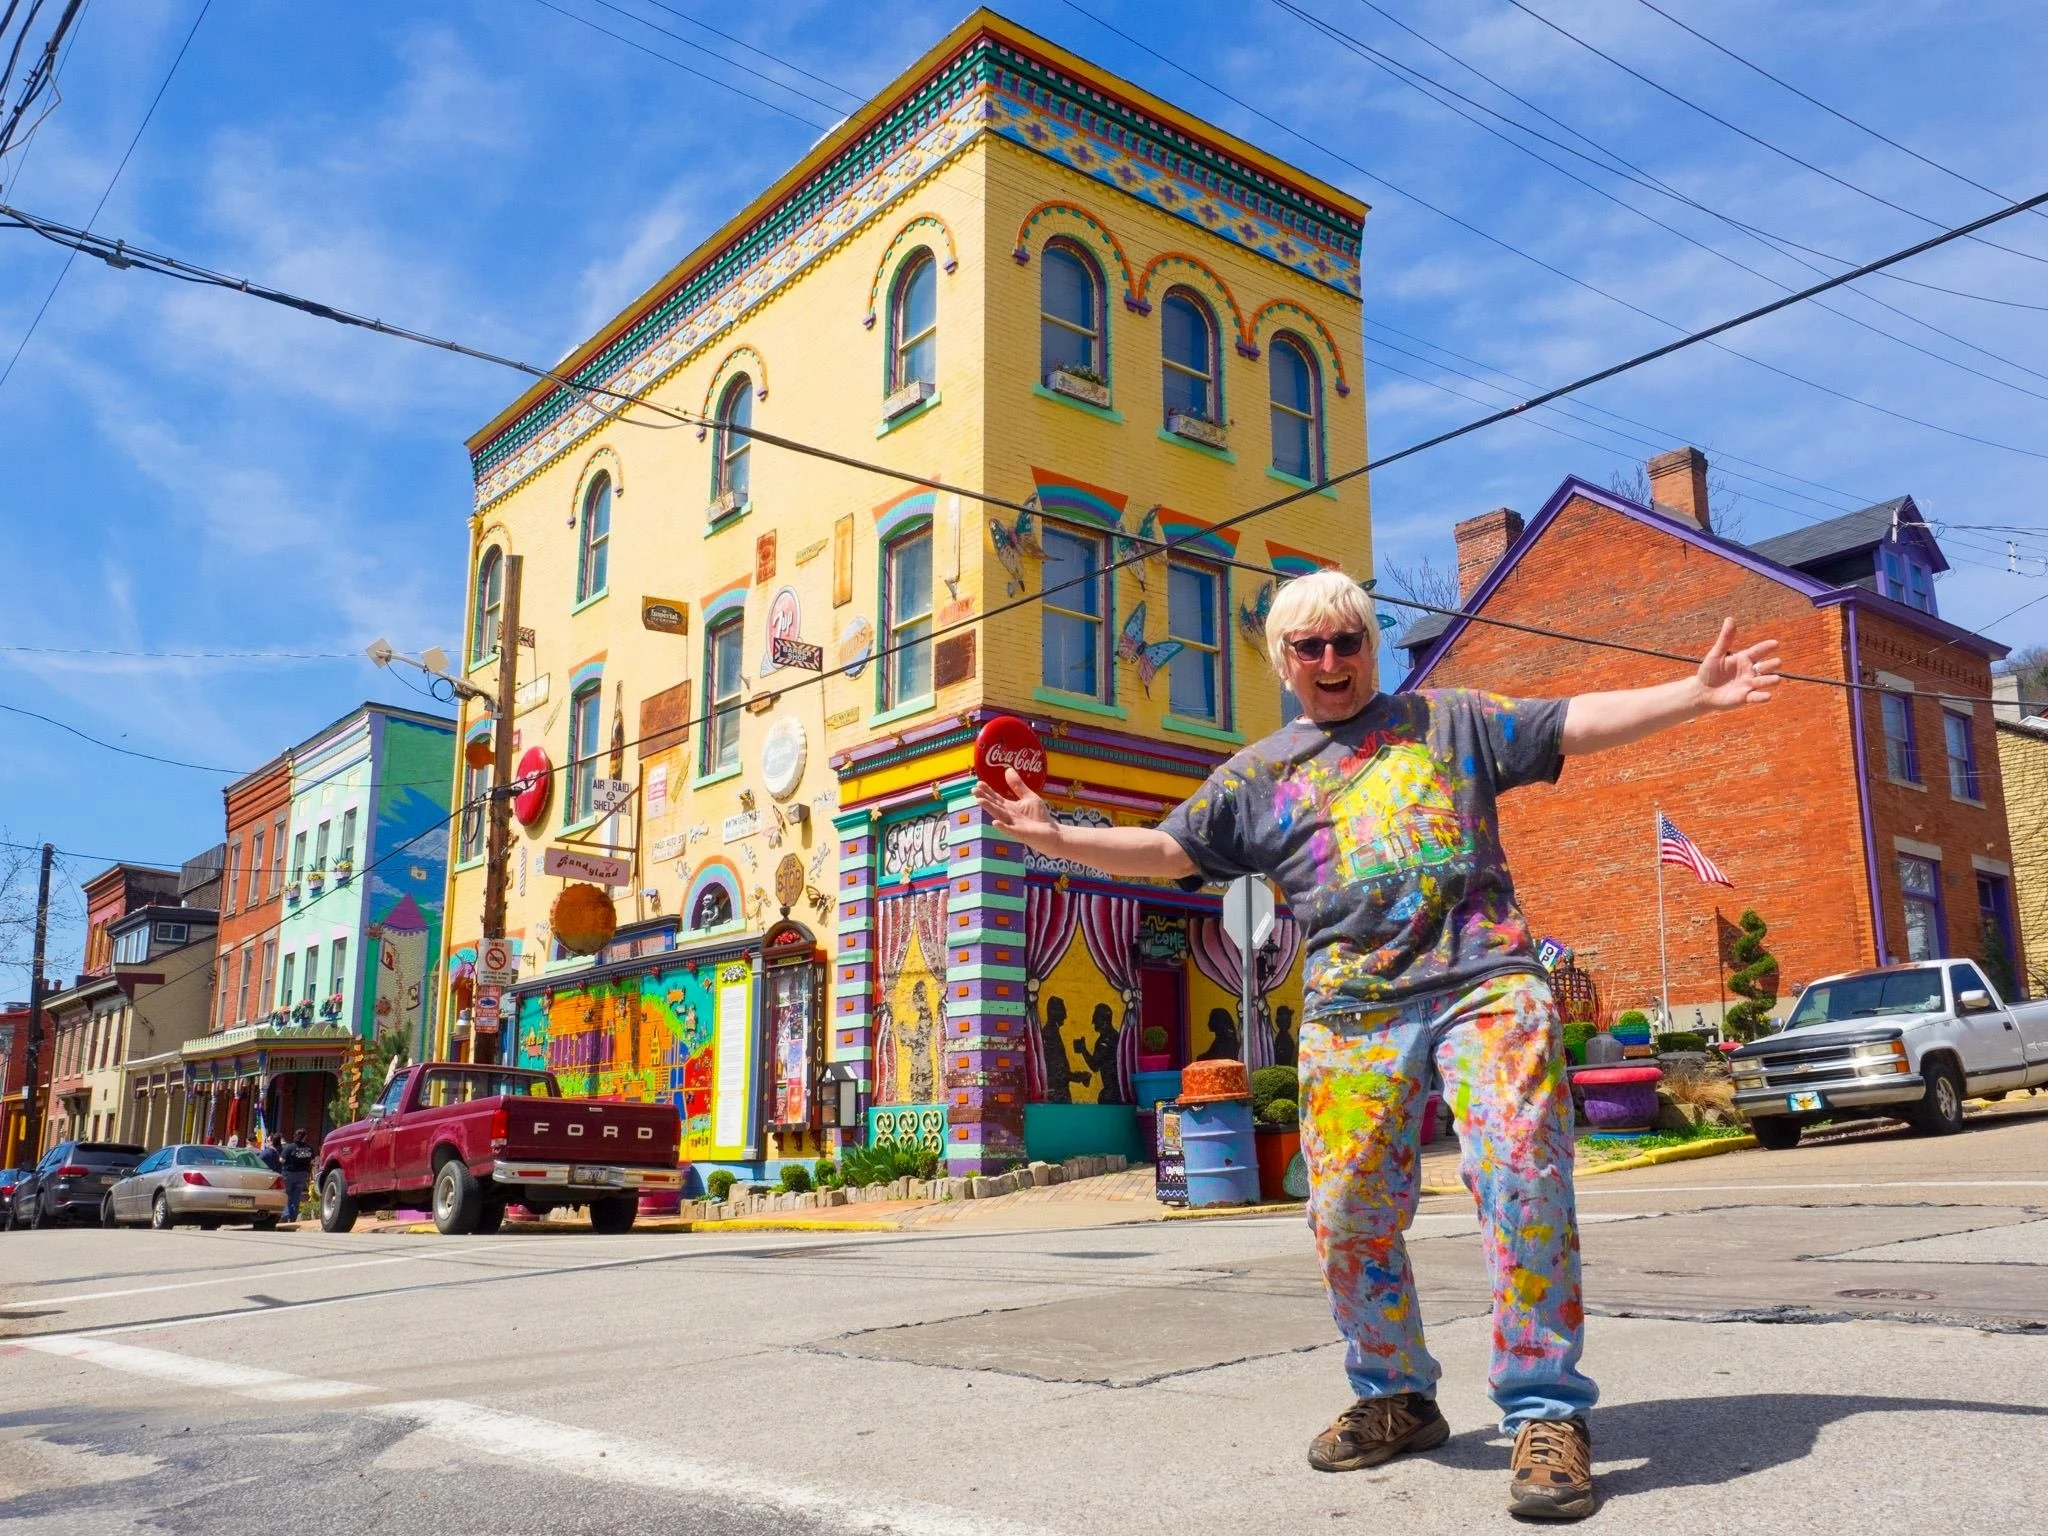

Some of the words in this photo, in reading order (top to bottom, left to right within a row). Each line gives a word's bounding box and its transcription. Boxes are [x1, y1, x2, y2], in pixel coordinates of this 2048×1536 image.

[783, 645, 811, 658] BARBER
[787, 652, 807, 662] SHOP
[985, 744, 1042, 773] Coca-Cola
[593, 780, 604, 790] AIR
[612, 782, 629, 793] RAID
[594, 800, 626, 813] SHELTER
[778, 869, 800, 892] STOP
[534, 1122, 653, 1140] FORD
